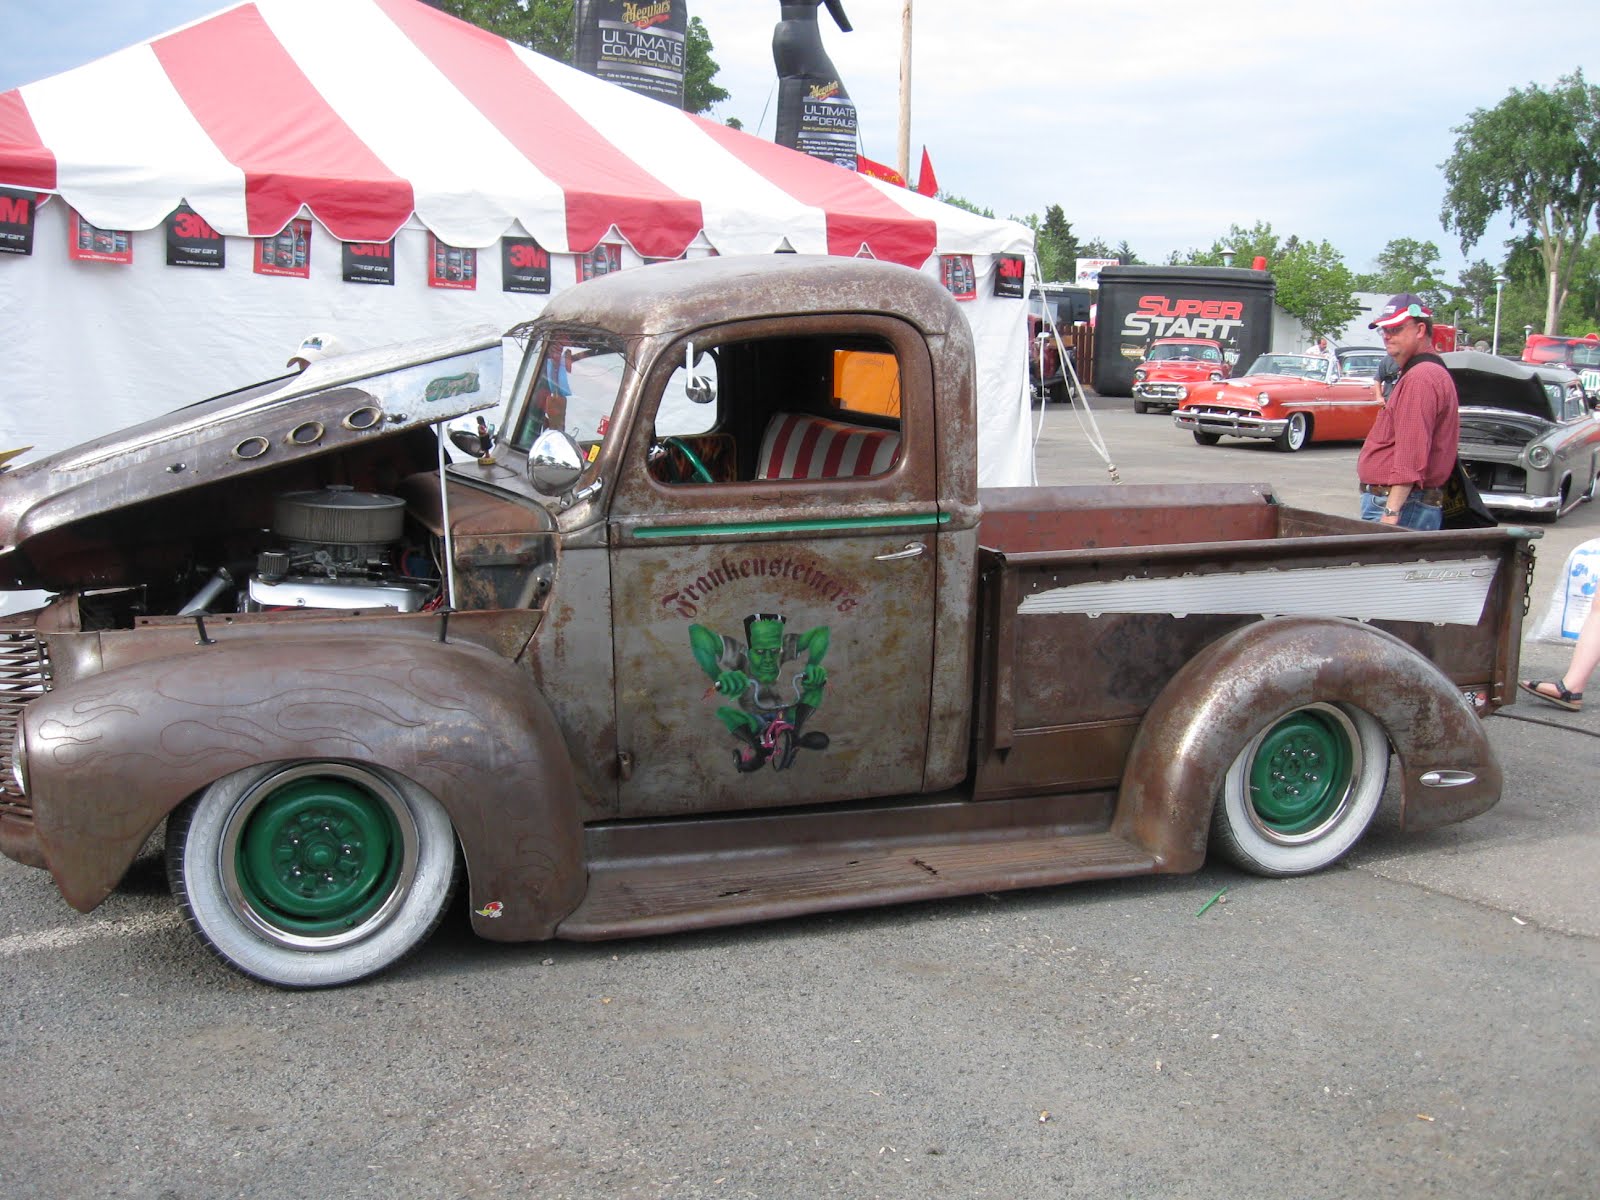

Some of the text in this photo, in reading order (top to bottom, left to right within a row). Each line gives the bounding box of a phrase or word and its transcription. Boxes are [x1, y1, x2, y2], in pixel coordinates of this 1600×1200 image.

[602, 30, 683, 56] ULTIMATE
[602, 43, 682, 67] COMPOUND
[804, 105, 856, 118] ULTIMATE
[0, 196, 29, 225] M
[7, 233, 26, 241] care
[175, 212, 220, 240] 3M
[510, 244, 548, 269] 3M
[999, 257, 1024, 279] 3M
[1135, 295, 1243, 320] SUPER
[1120, 312, 1243, 340] START
